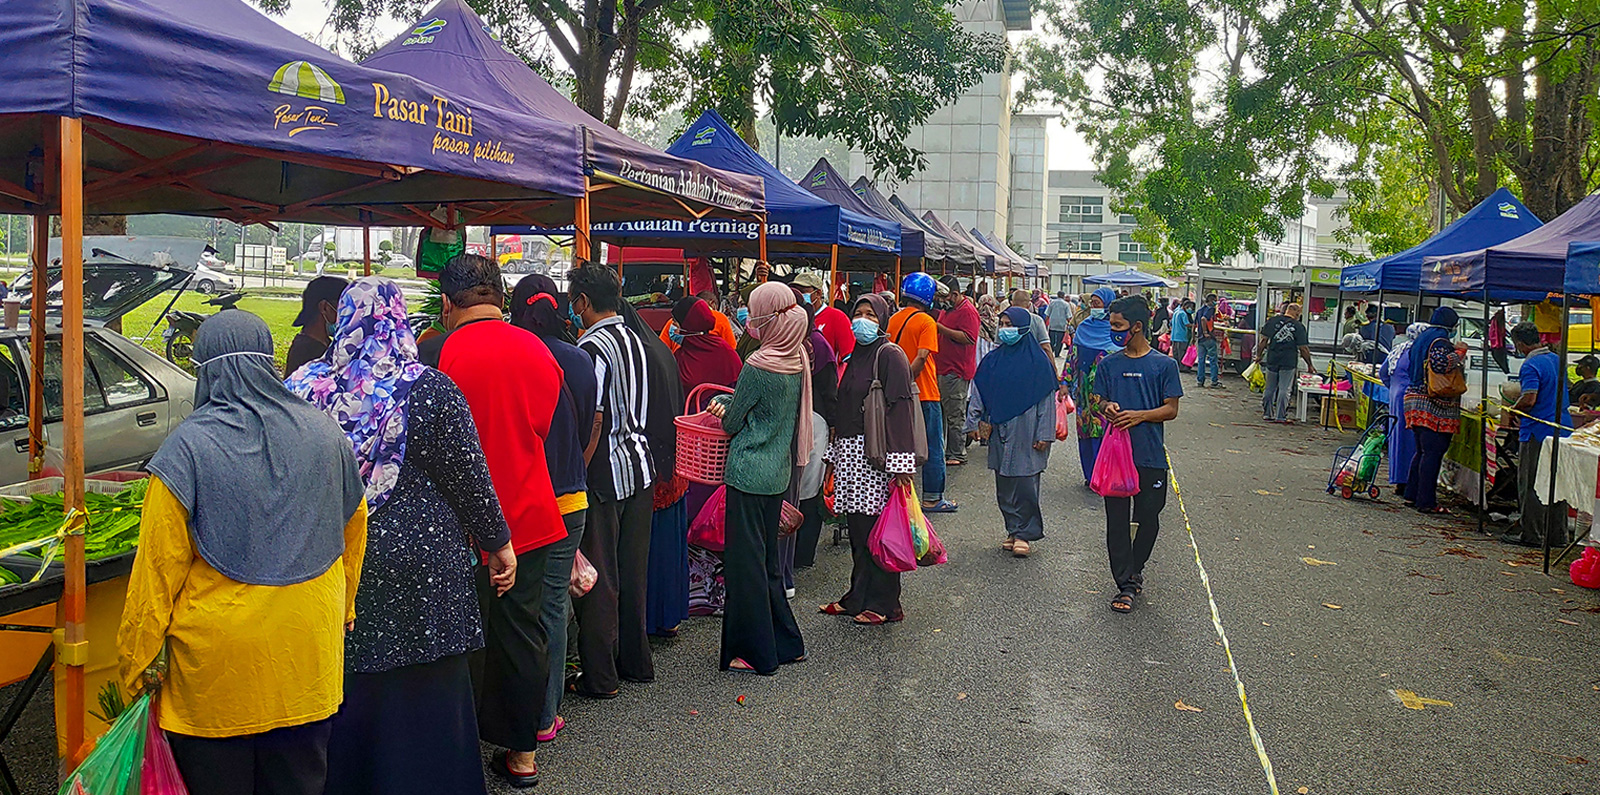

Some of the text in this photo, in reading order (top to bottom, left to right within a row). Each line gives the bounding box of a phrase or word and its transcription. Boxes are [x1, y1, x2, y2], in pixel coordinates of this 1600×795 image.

[274, 104, 338, 130] Pasar Tani
[372, 83, 473, 136] Pasar Tani
[431, 132, 515, 165] pasar pilihan
[620, 159, 675, 193] Pertanian
[676, 170, 711, 200] Adalah
[687, 219, 793, 239] Perniagan
